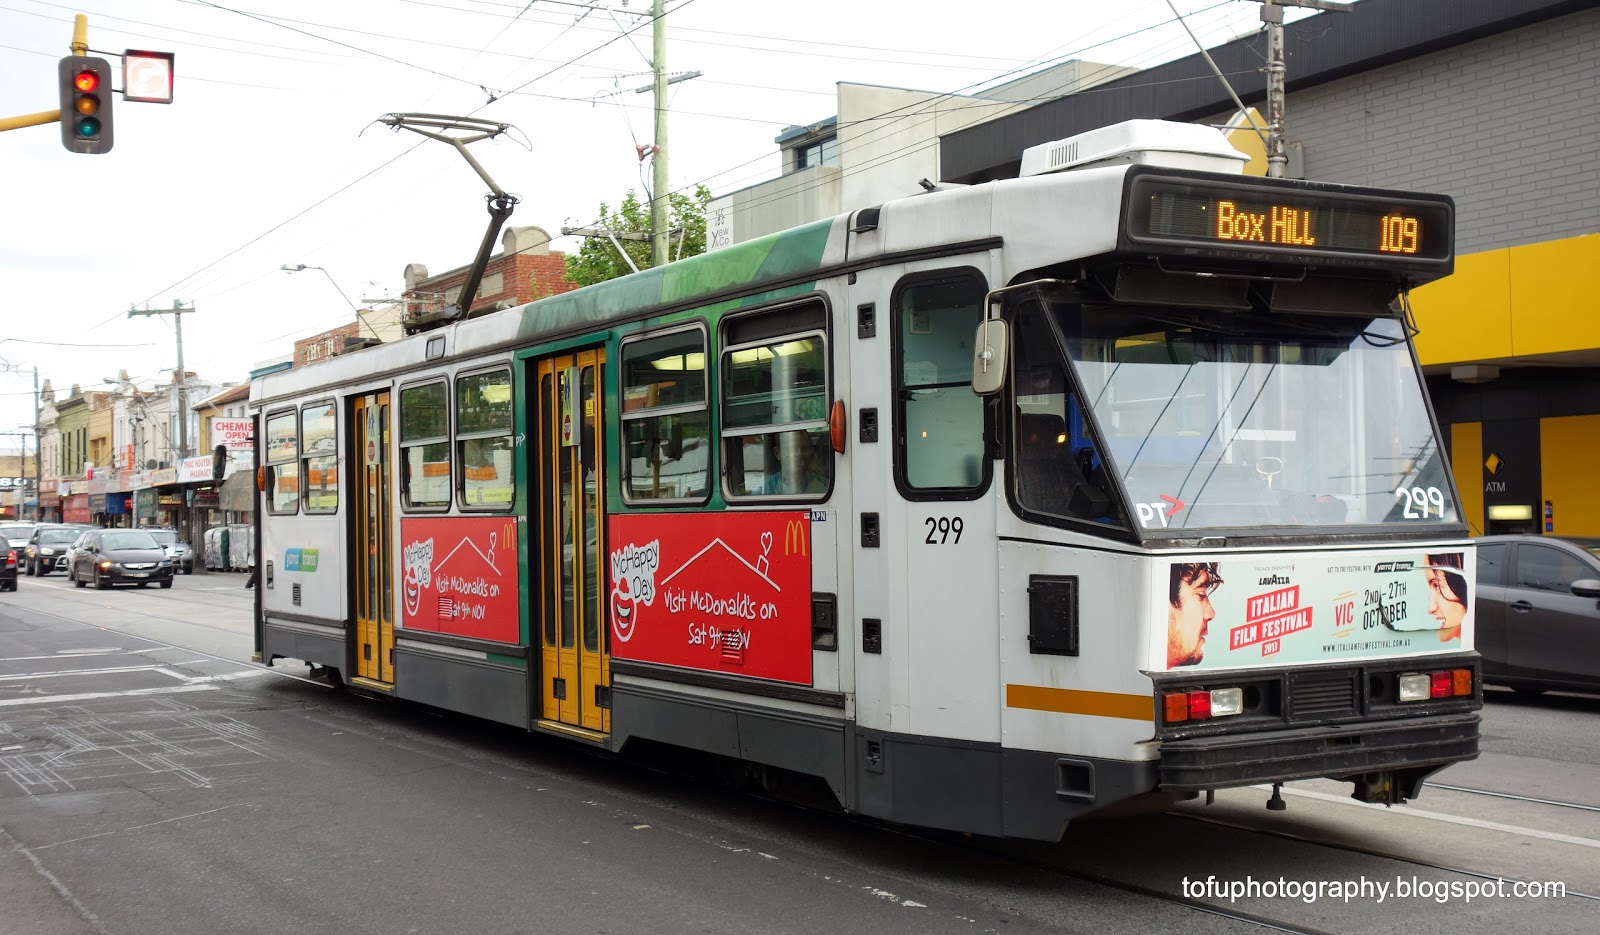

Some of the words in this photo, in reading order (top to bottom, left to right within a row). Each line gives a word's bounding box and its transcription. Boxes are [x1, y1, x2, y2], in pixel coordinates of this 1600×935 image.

[1218, 202, 1265, 241] Box
[1380, 215, 1418, 253] 109
[215, 422, 255, 432] CHEMIS
[225, 431, 249, 439] OPEN
[190, 468, 211, 479] PHARMACY
[1485, 481, 1506, 492] ATM
[1395, 486, 1444, 519] 299
[811, 511, 826, 521] APN
[924, 516, 964, 545] 299
[612, 544, 658, 578] McHappy
[417, 565, 430, 585] Day
[451, 576, 488, 597] McDonald's
[490, 584, 500, 597] on
[1259, 574, 1290, 585] LAVAZZA
[633, 575, 653, 602] Day
[1364, 589, 1379, 607] 2ND
[1388, 581, 1407, 600] 27TH
[690, 590, 756, 620] McDonald's
[760, 602, 778, 620] on
[1251, 590, 1295, 618] ITALIAN
[1335, 601, 1354, 627] VIC
[688, 622, 707, 645] Sat
[1233, 625, 1257, 647] FILM
[1262, 611, 1308, 639] FESTIVAL
[1264, 642, 1278, 654] 2013
[1322, 638, 1411, 653] WWW.ITALIANFILMFESTIVAL.COM.AU
